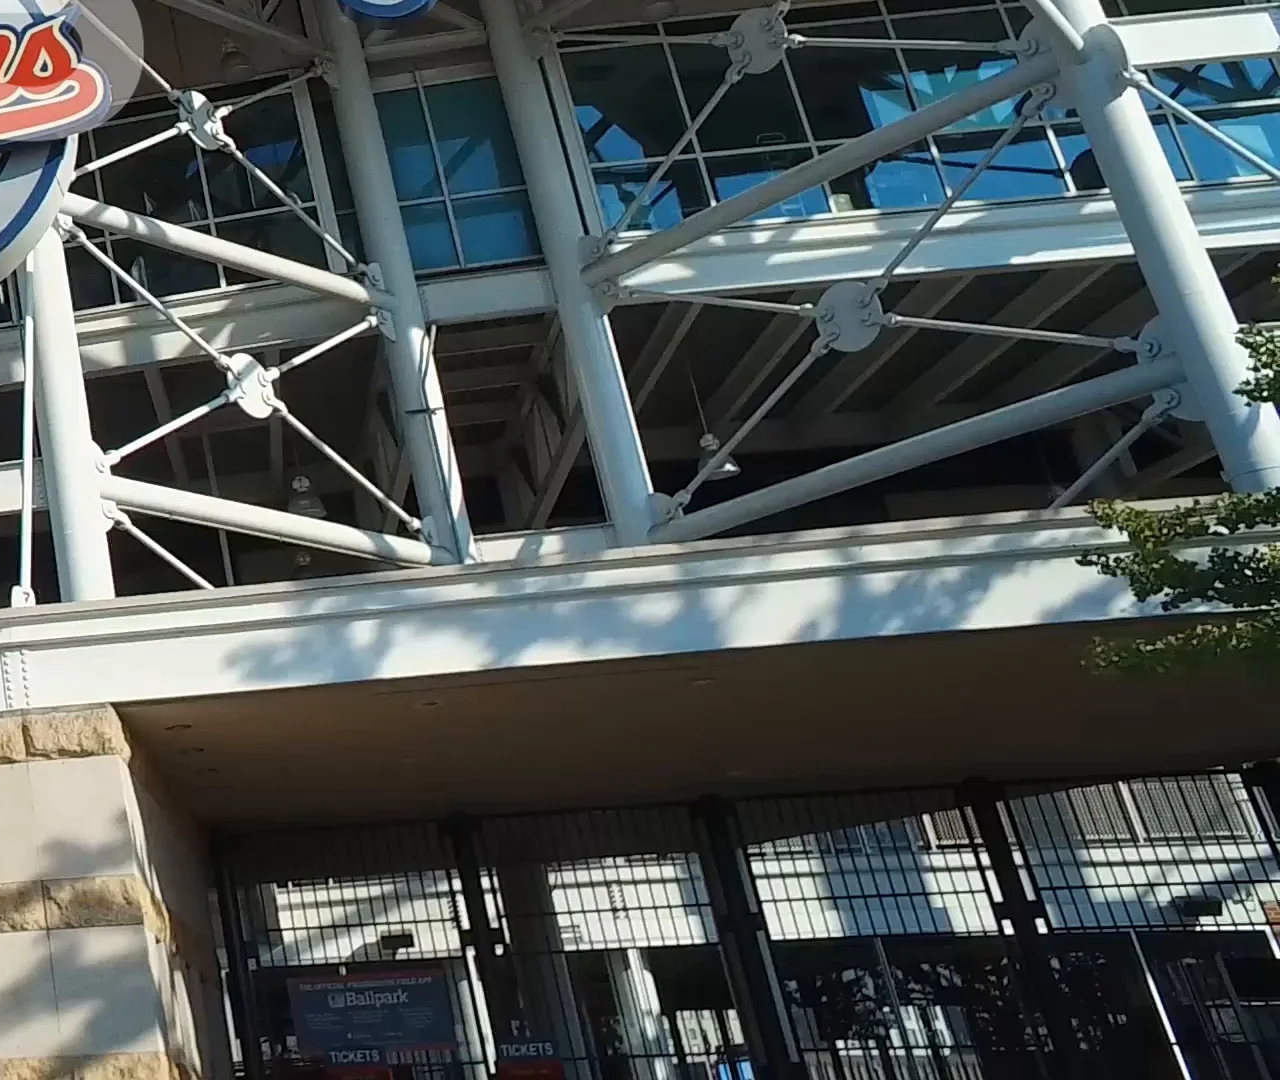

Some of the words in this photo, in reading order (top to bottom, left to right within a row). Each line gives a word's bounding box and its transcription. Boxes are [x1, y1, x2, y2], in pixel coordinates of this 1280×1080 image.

[345, 988, 409, 1008] Ballpark
[329, 1049, 380, 1064] TICKETS
[499, 1042, 554, 1057] TICKETS
